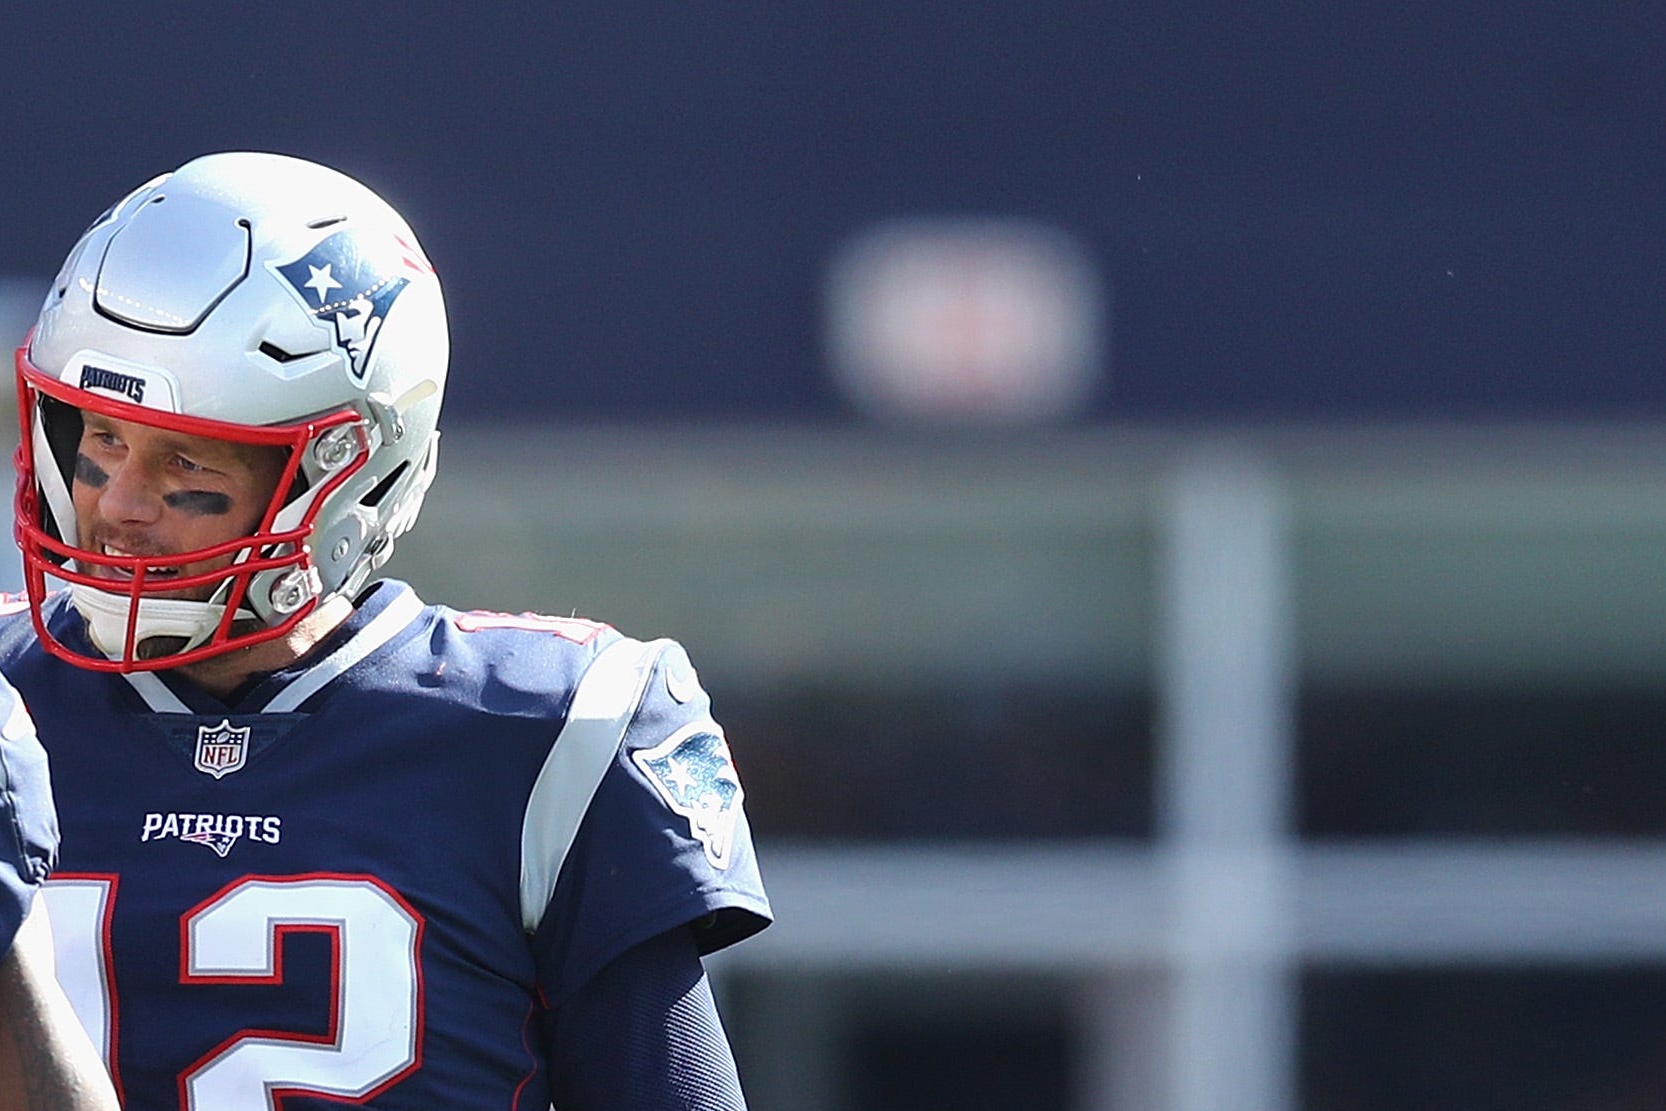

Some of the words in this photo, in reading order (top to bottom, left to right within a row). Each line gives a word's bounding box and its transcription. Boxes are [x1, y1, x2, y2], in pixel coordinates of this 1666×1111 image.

[79, 365, 146, 404] PATRIOTS
[203, 746, 238, 767] NFL
[141, 813, 281, 844] PATRIOTS
